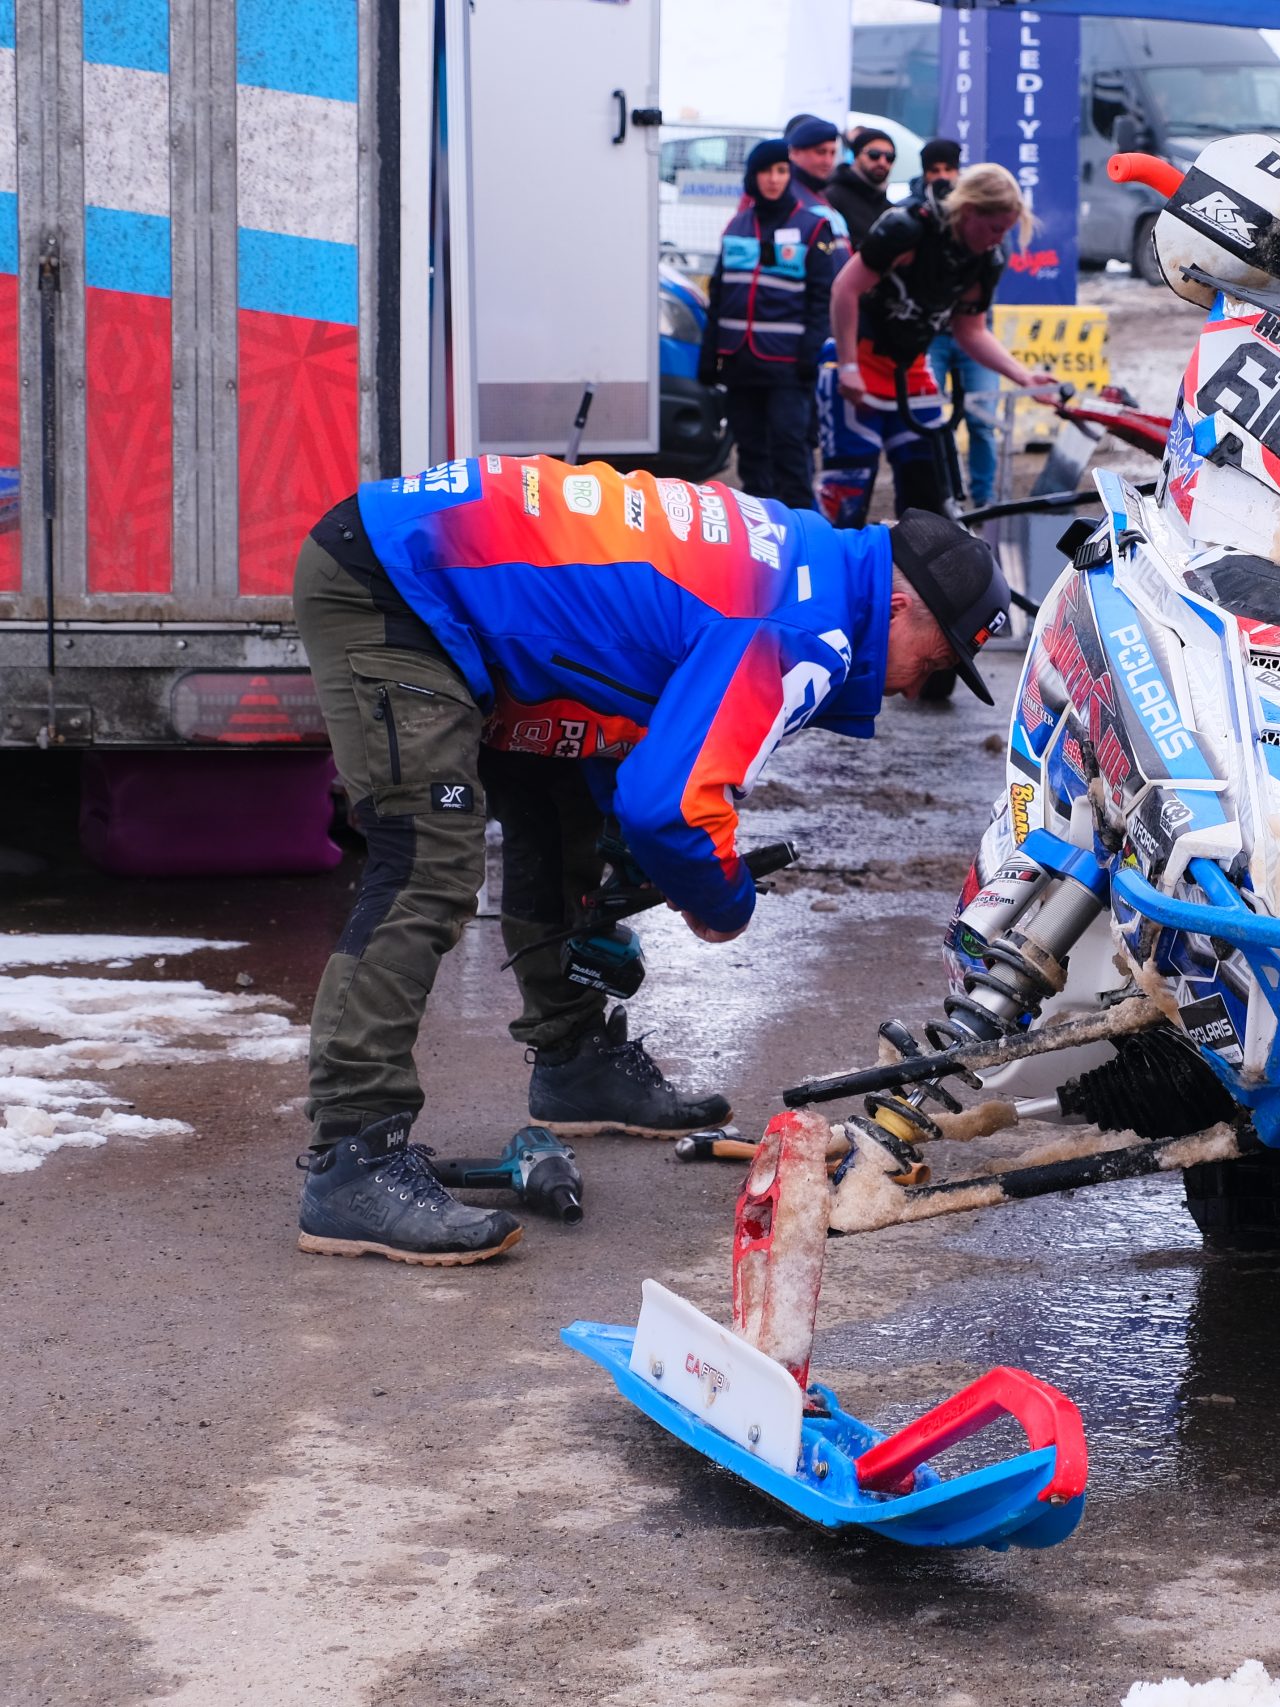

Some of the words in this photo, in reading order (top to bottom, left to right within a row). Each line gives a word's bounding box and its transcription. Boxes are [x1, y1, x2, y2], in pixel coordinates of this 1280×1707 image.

[573, 480, 592, 509] BRO
[1109, 623, 1195, 761] POLARIS
[989, 895, 1016, 906] Evans
[1188, 1018, 1233, 1044] POLARIS
